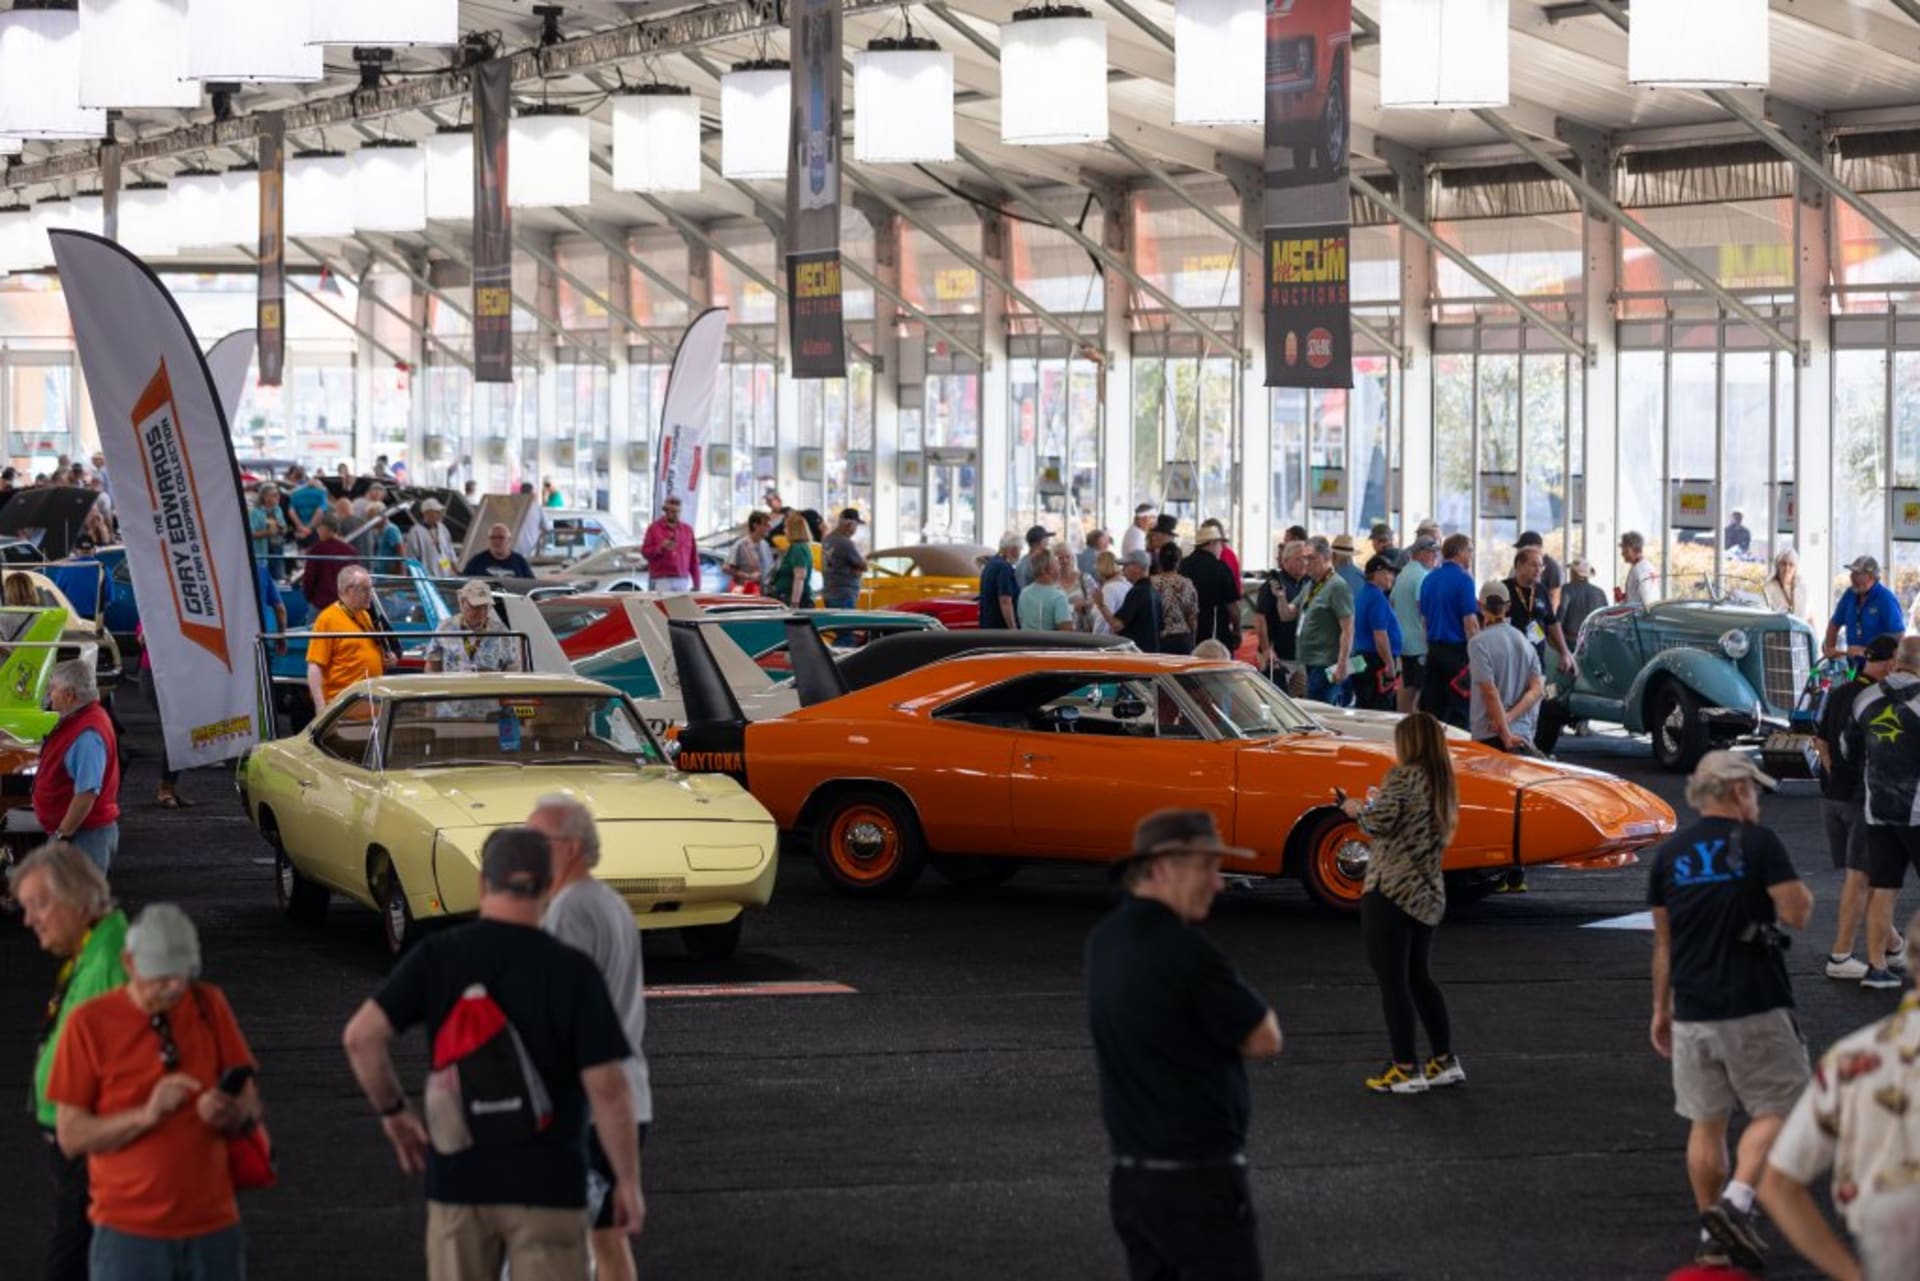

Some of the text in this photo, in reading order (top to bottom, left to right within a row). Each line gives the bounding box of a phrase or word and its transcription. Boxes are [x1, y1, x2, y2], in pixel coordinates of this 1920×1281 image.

[1272, 238, 1346, 283] MECUM
[1272, 284, 1347, 305] AUCTIONS
[161, 417, 186, 492] COLLECTION
[146, 425, 203, 615] GARY EDWARDS
[153, 514, 165, 536] THE
[179, 496, 198, 541] MOPAR
[200, 584, 215, 617] WING
[680, 752, 742, 770] DAYTONA
[1674, 840, 1744, 878] SY
